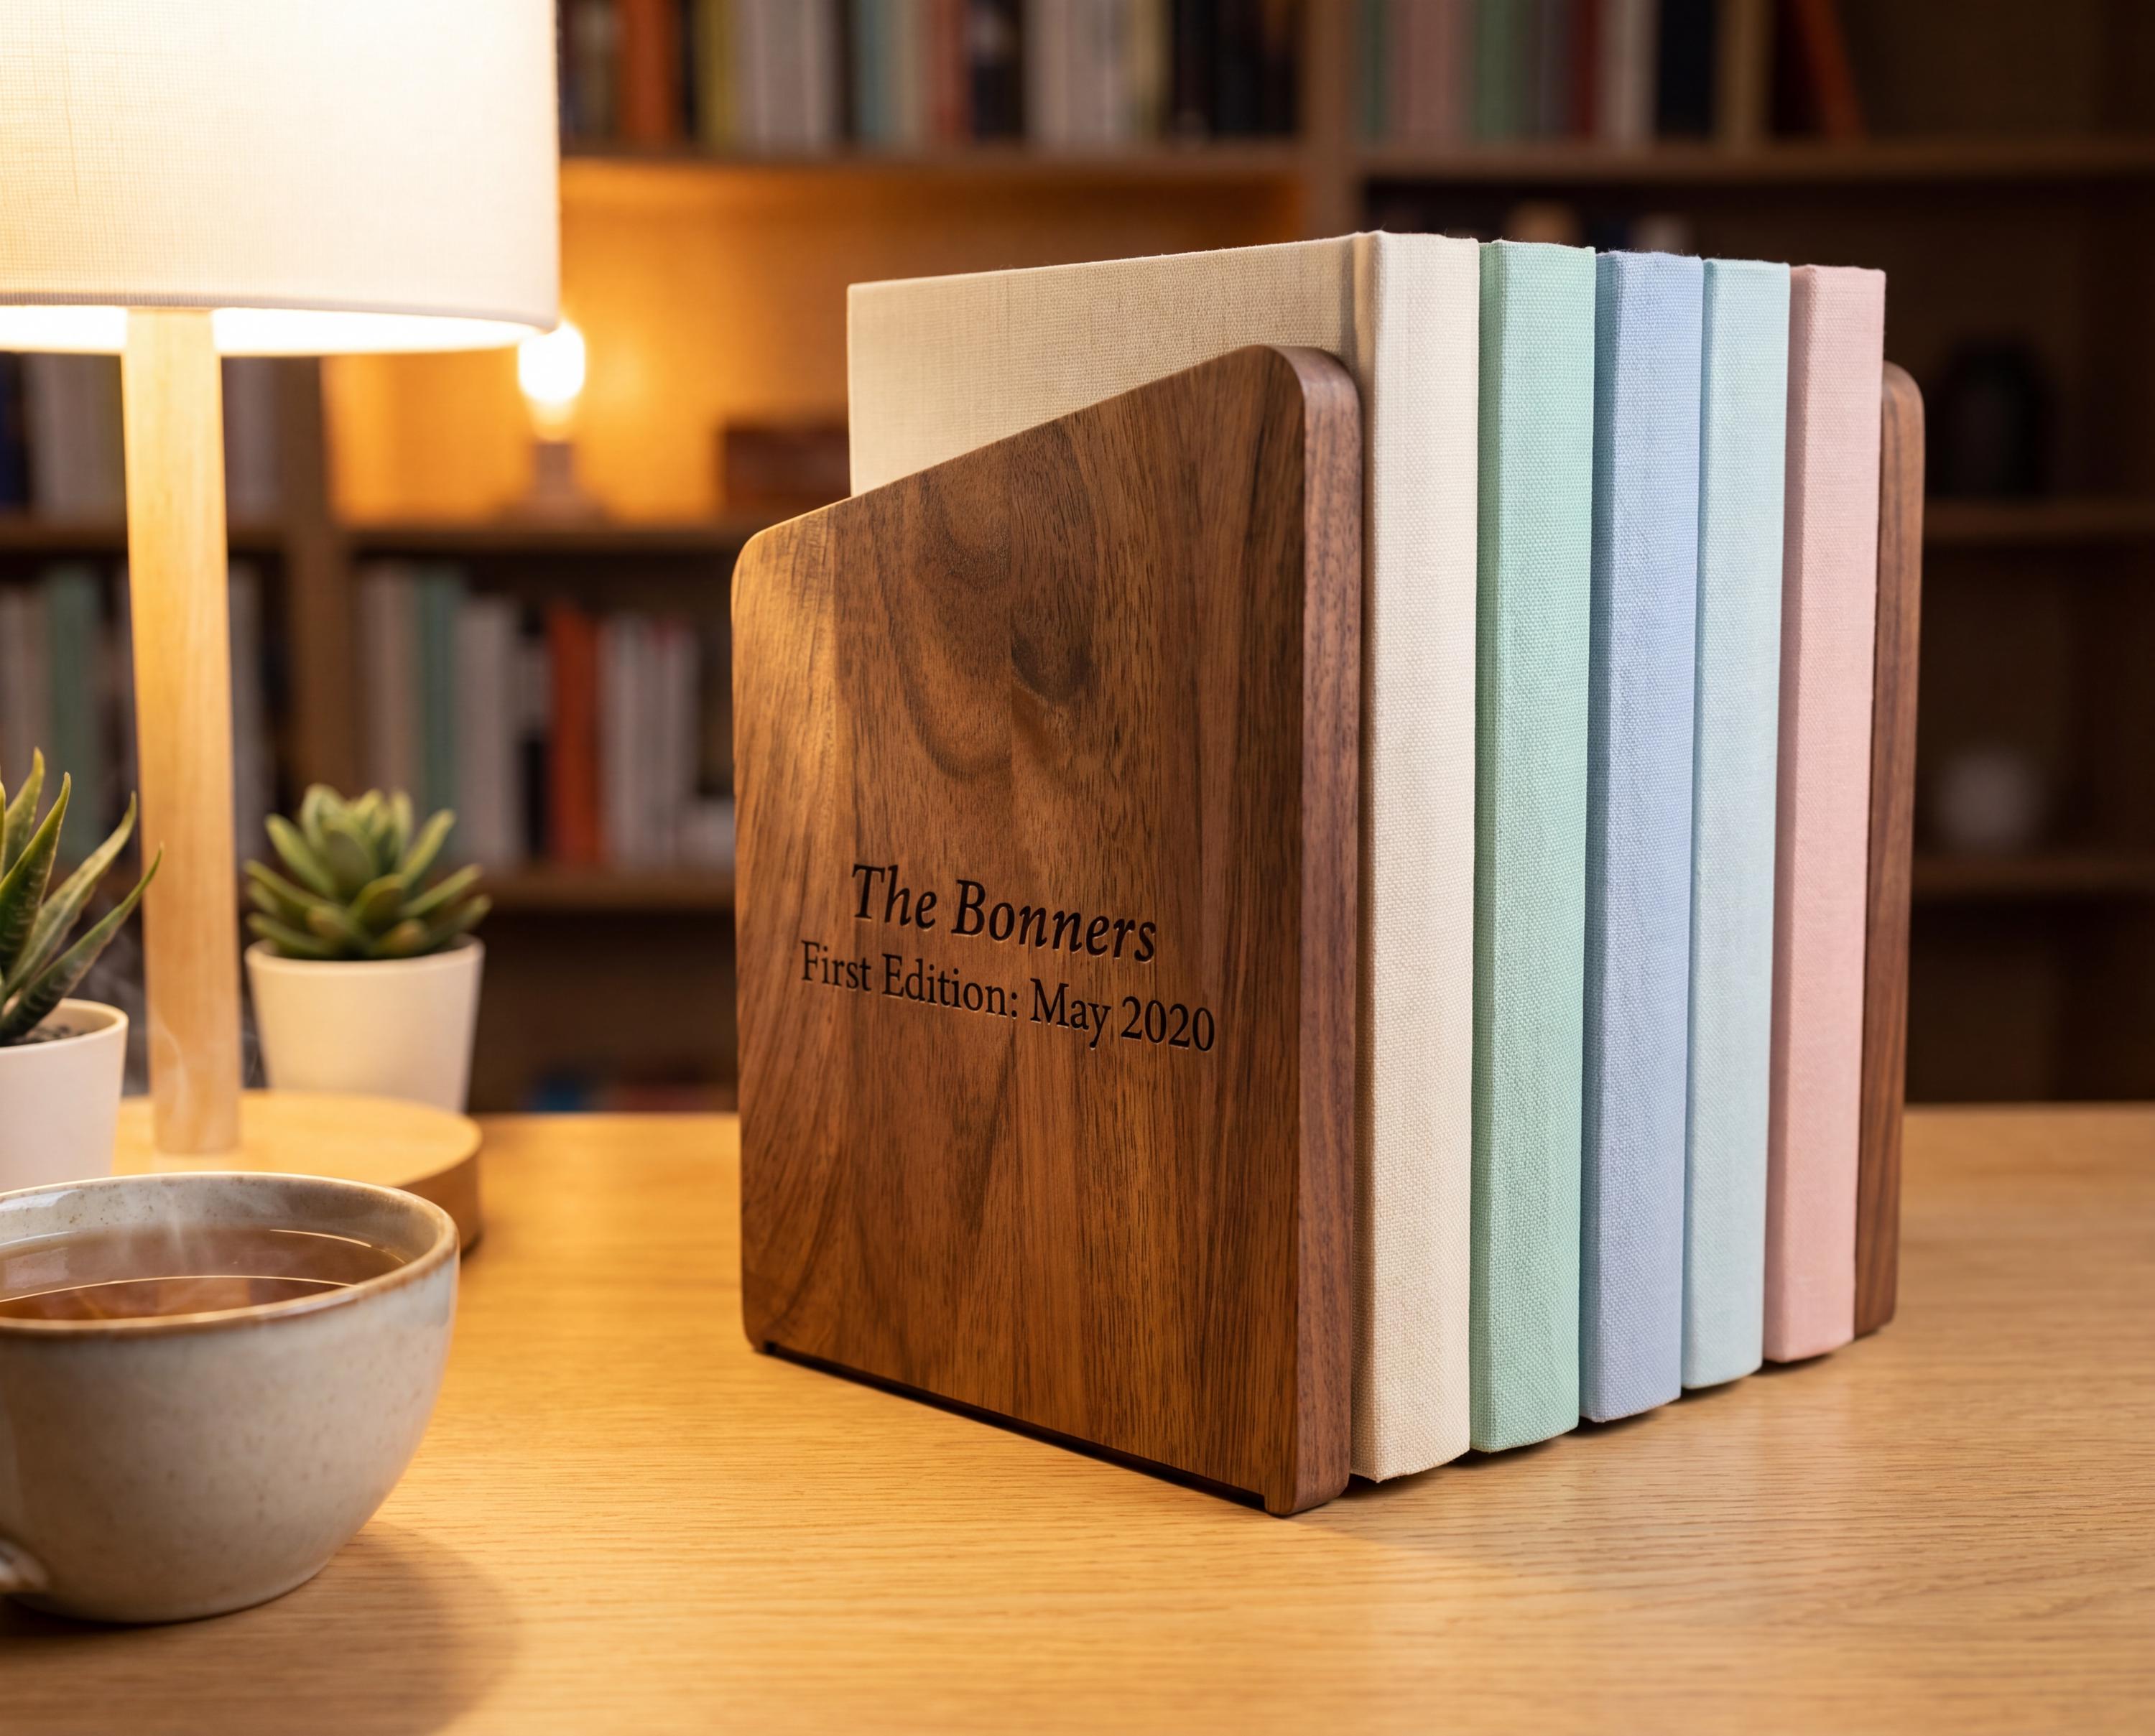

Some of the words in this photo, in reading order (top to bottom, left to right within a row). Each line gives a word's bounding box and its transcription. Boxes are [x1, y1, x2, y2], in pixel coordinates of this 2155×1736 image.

[852, 864, 937, 931] The
[951, 879, 1157, 963] Bonners
[800, 940, 871, 991] First
[881, 953, 1018, 1018] Edition:
[1030, 978, 1111, 1049] May
[1121, 996, 1215, 1052] 2020
